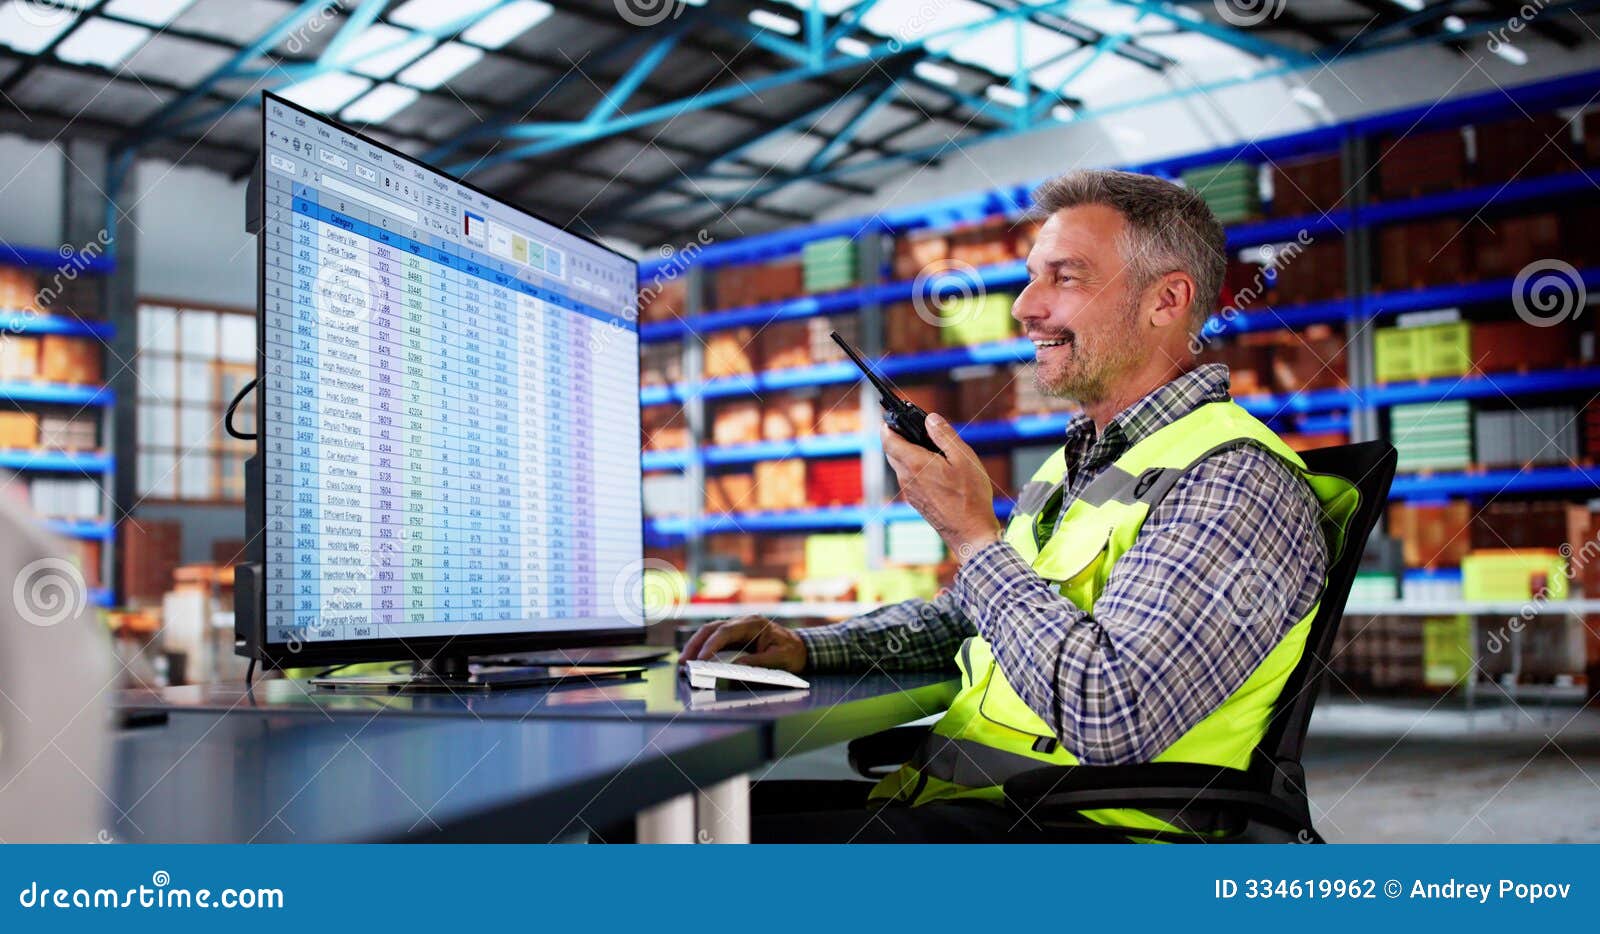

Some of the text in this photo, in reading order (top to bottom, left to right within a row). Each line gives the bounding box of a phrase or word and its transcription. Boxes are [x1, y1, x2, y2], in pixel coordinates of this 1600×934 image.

[273, 106, 284, 119] File
[295, 116, 306, 129] Edit
[317, 126, 331, 140] View
[341, 136, 359, 151] Format
[368, 150, 383, 162] Insert
[330, 214, 354, 230] Category
[379, 232, 390, 241] Low
[377, 246, 390, 258] 25011
[409, 241, 420, 254] High
[299, 248, 310, 260] 435
[378, 260, 389, 272] 1212
[344, 336, 359, 347] Room
[335, 363, 361, 376] Resolution
[340, 393, 358, 405] System
[341, 423, 361, 434] Therapy
[320, 434, 364, 449] Business Evolving
[378, 443, 391, 452] 4344
[326, 450, 336, 459] Car
[301, 477, 308, 486] 24
[326, 480, 361, 492] Class Cooking
[327, 495, 360, 505] Edition Video
[323, 509, 362, 521] Efficient Energy
[325, 525, 361, 536] Manufacturing
[327, 540, 347, 550] Hosting
[338, 556, 361, 564] Interface
[301, 585, 311, 593] 342
[380, 585, 392, 593] 1377
[348, 615, 367, 624] Symbol
[354, 627, 371, 637] Table3
